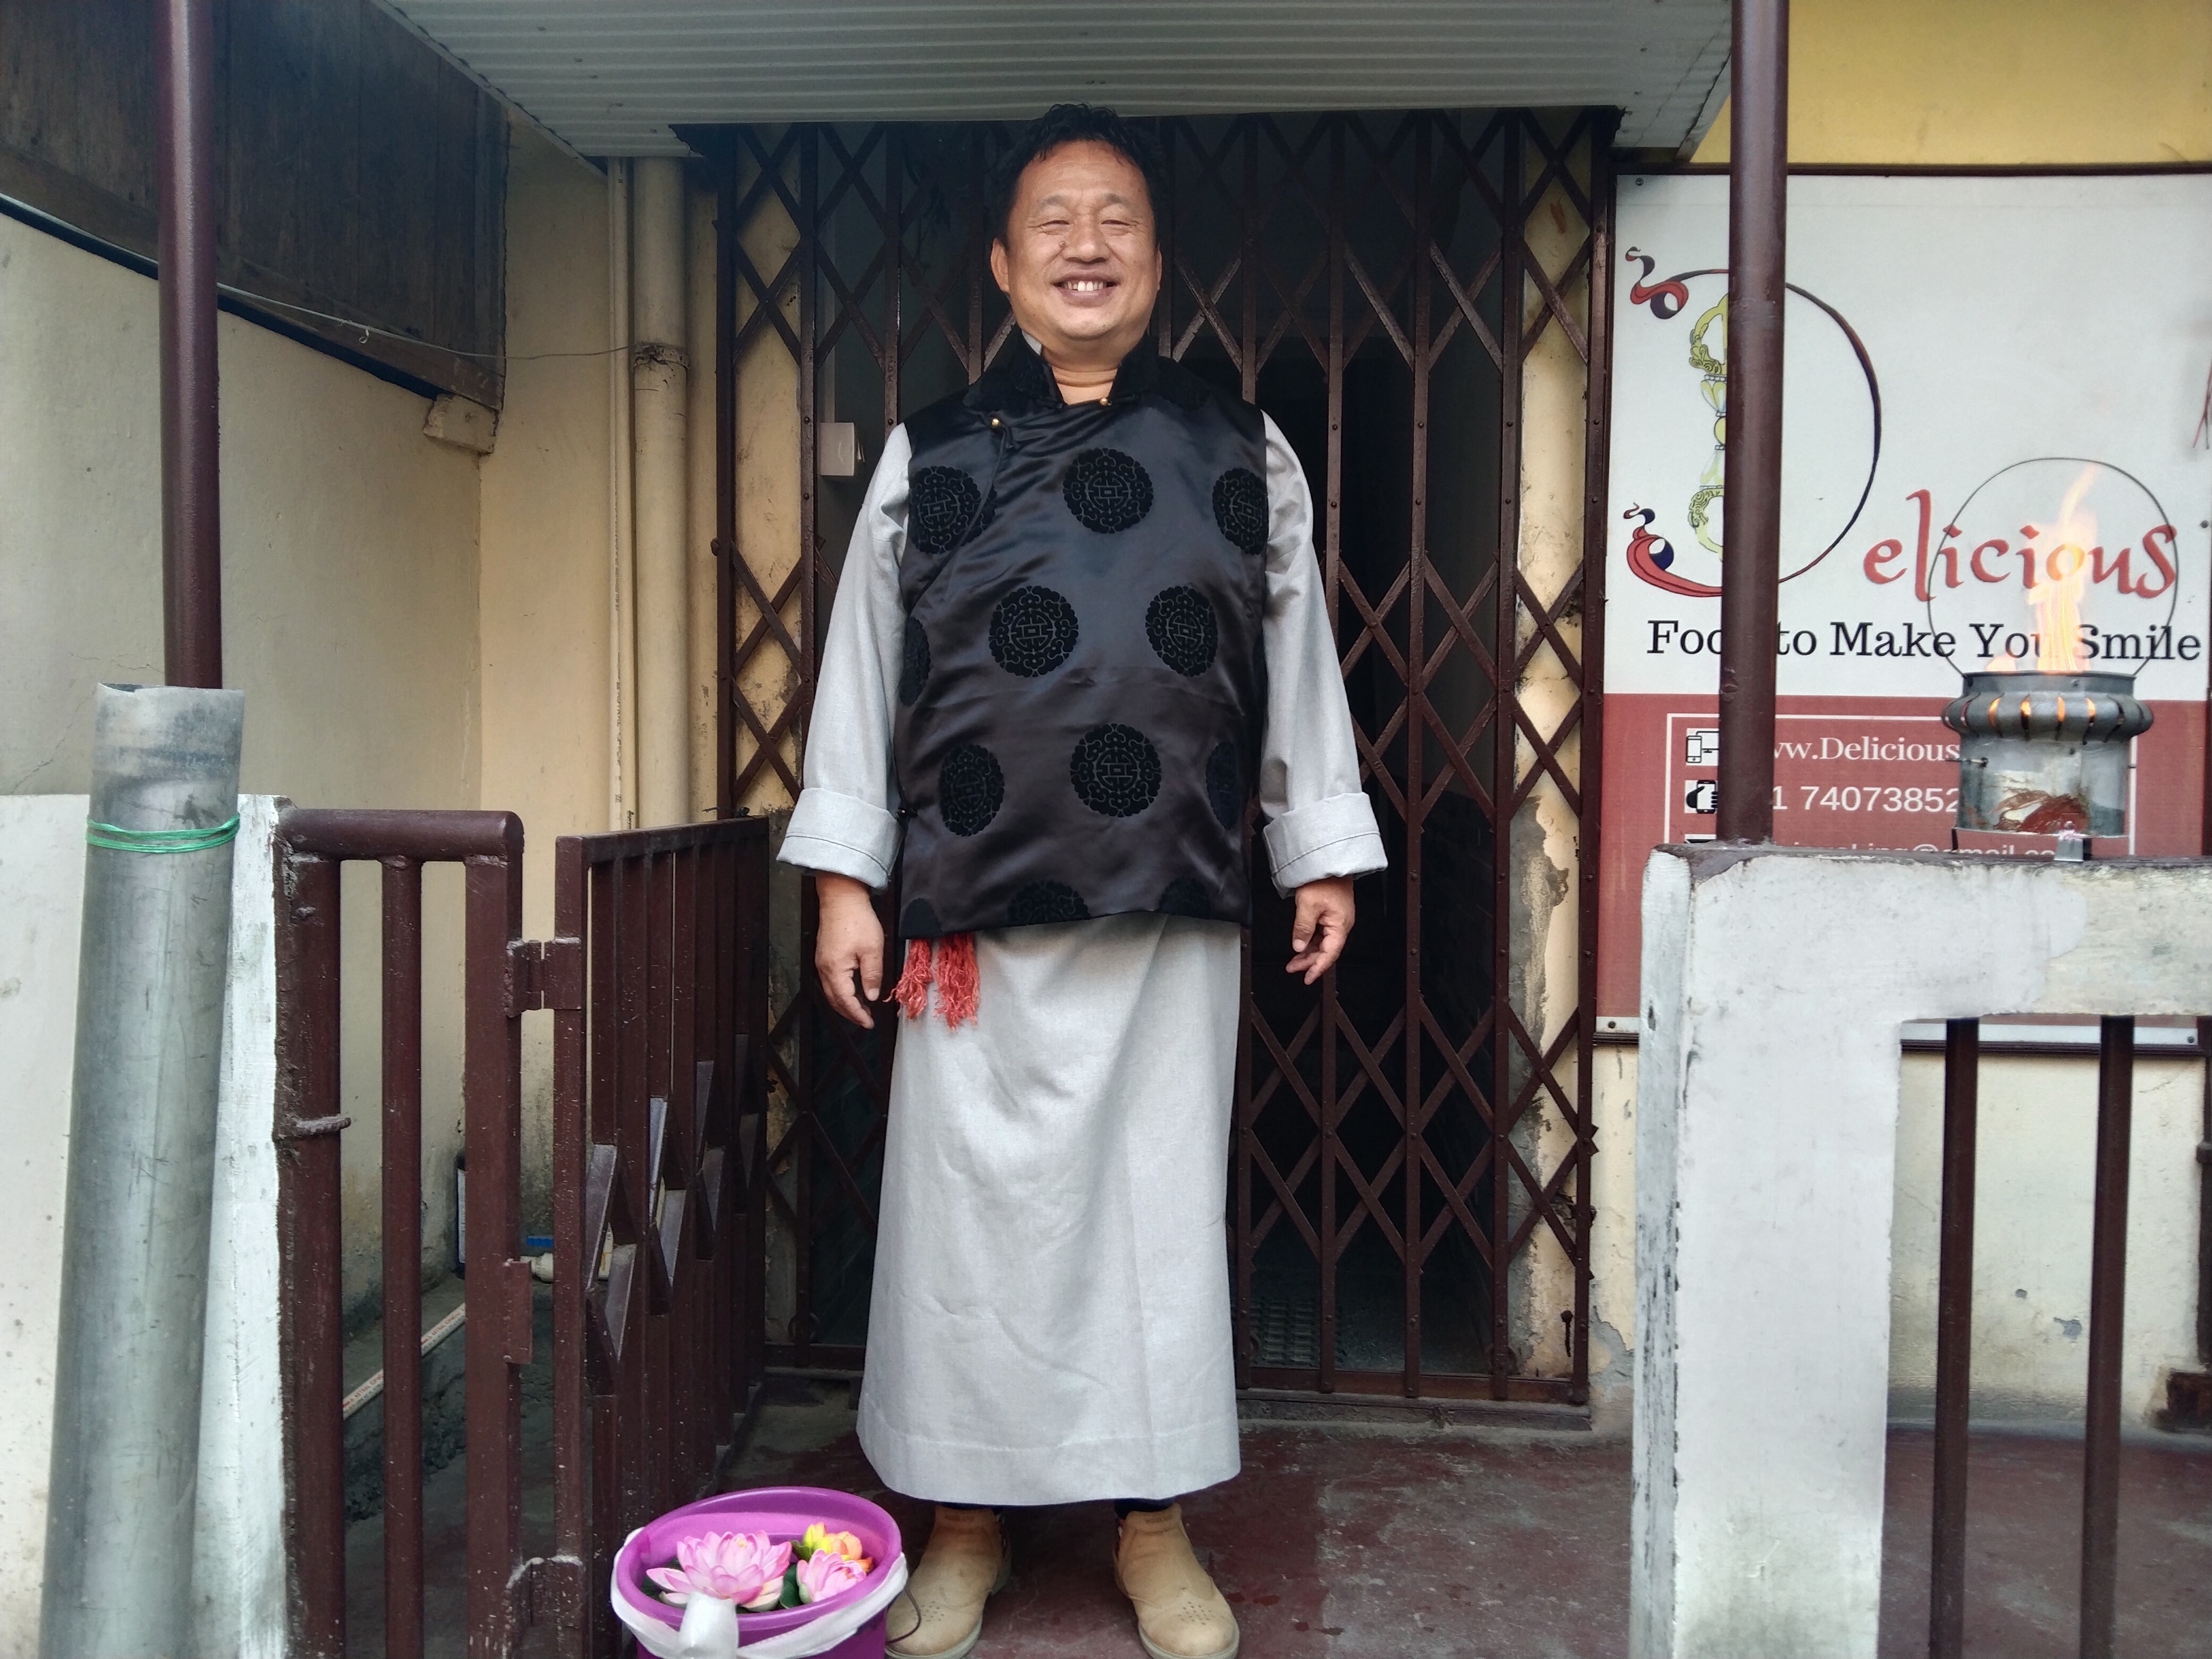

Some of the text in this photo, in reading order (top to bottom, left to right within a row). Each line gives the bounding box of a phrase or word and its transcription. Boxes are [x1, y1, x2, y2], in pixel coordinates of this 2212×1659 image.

[1647, 620, 1722, 655] Foo
[1777, 621, 1816, 655] to
[1830, 622, 1956, 657] Make
[2073, 624, 2201, 659] Smile
[1773, 786, 1959, 812] 1 74073852
